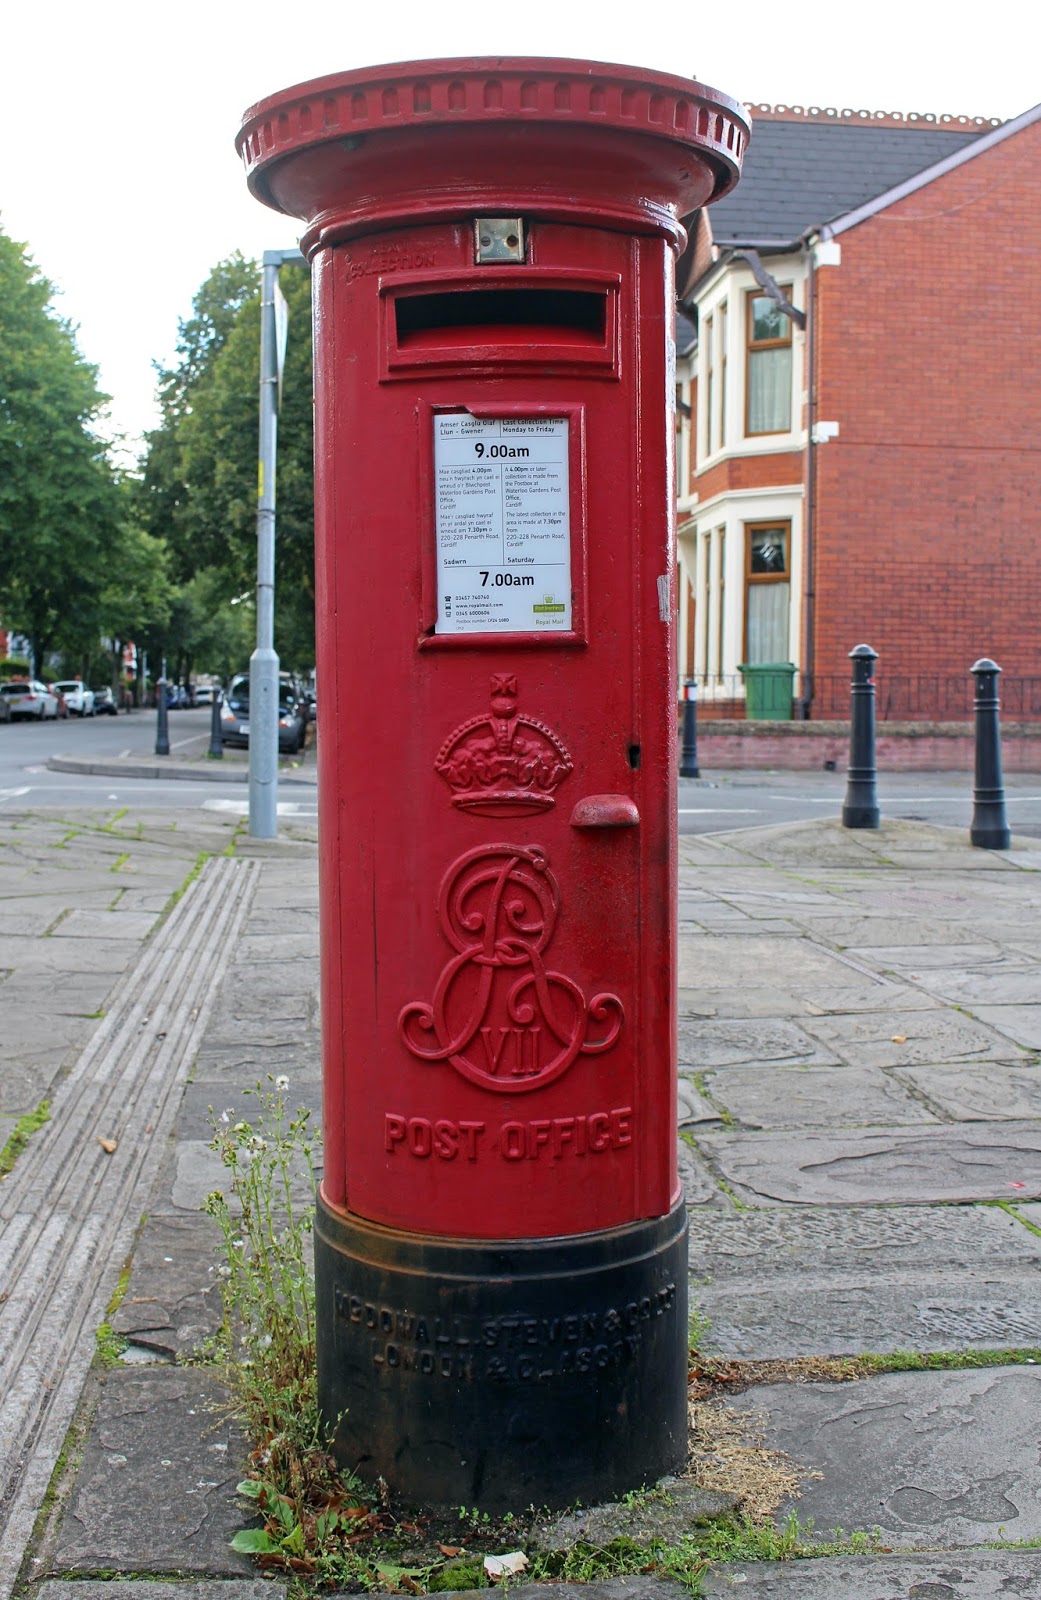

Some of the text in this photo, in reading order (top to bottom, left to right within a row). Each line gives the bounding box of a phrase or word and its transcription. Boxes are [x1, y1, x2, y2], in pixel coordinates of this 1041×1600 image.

[474, 442, 530, 458] 9.00am
[480, 572, 534, 586] 7.00am
[480, 1026, 541, 1075] VII
[385, 1106, 632, 1162] POST OFFICE
